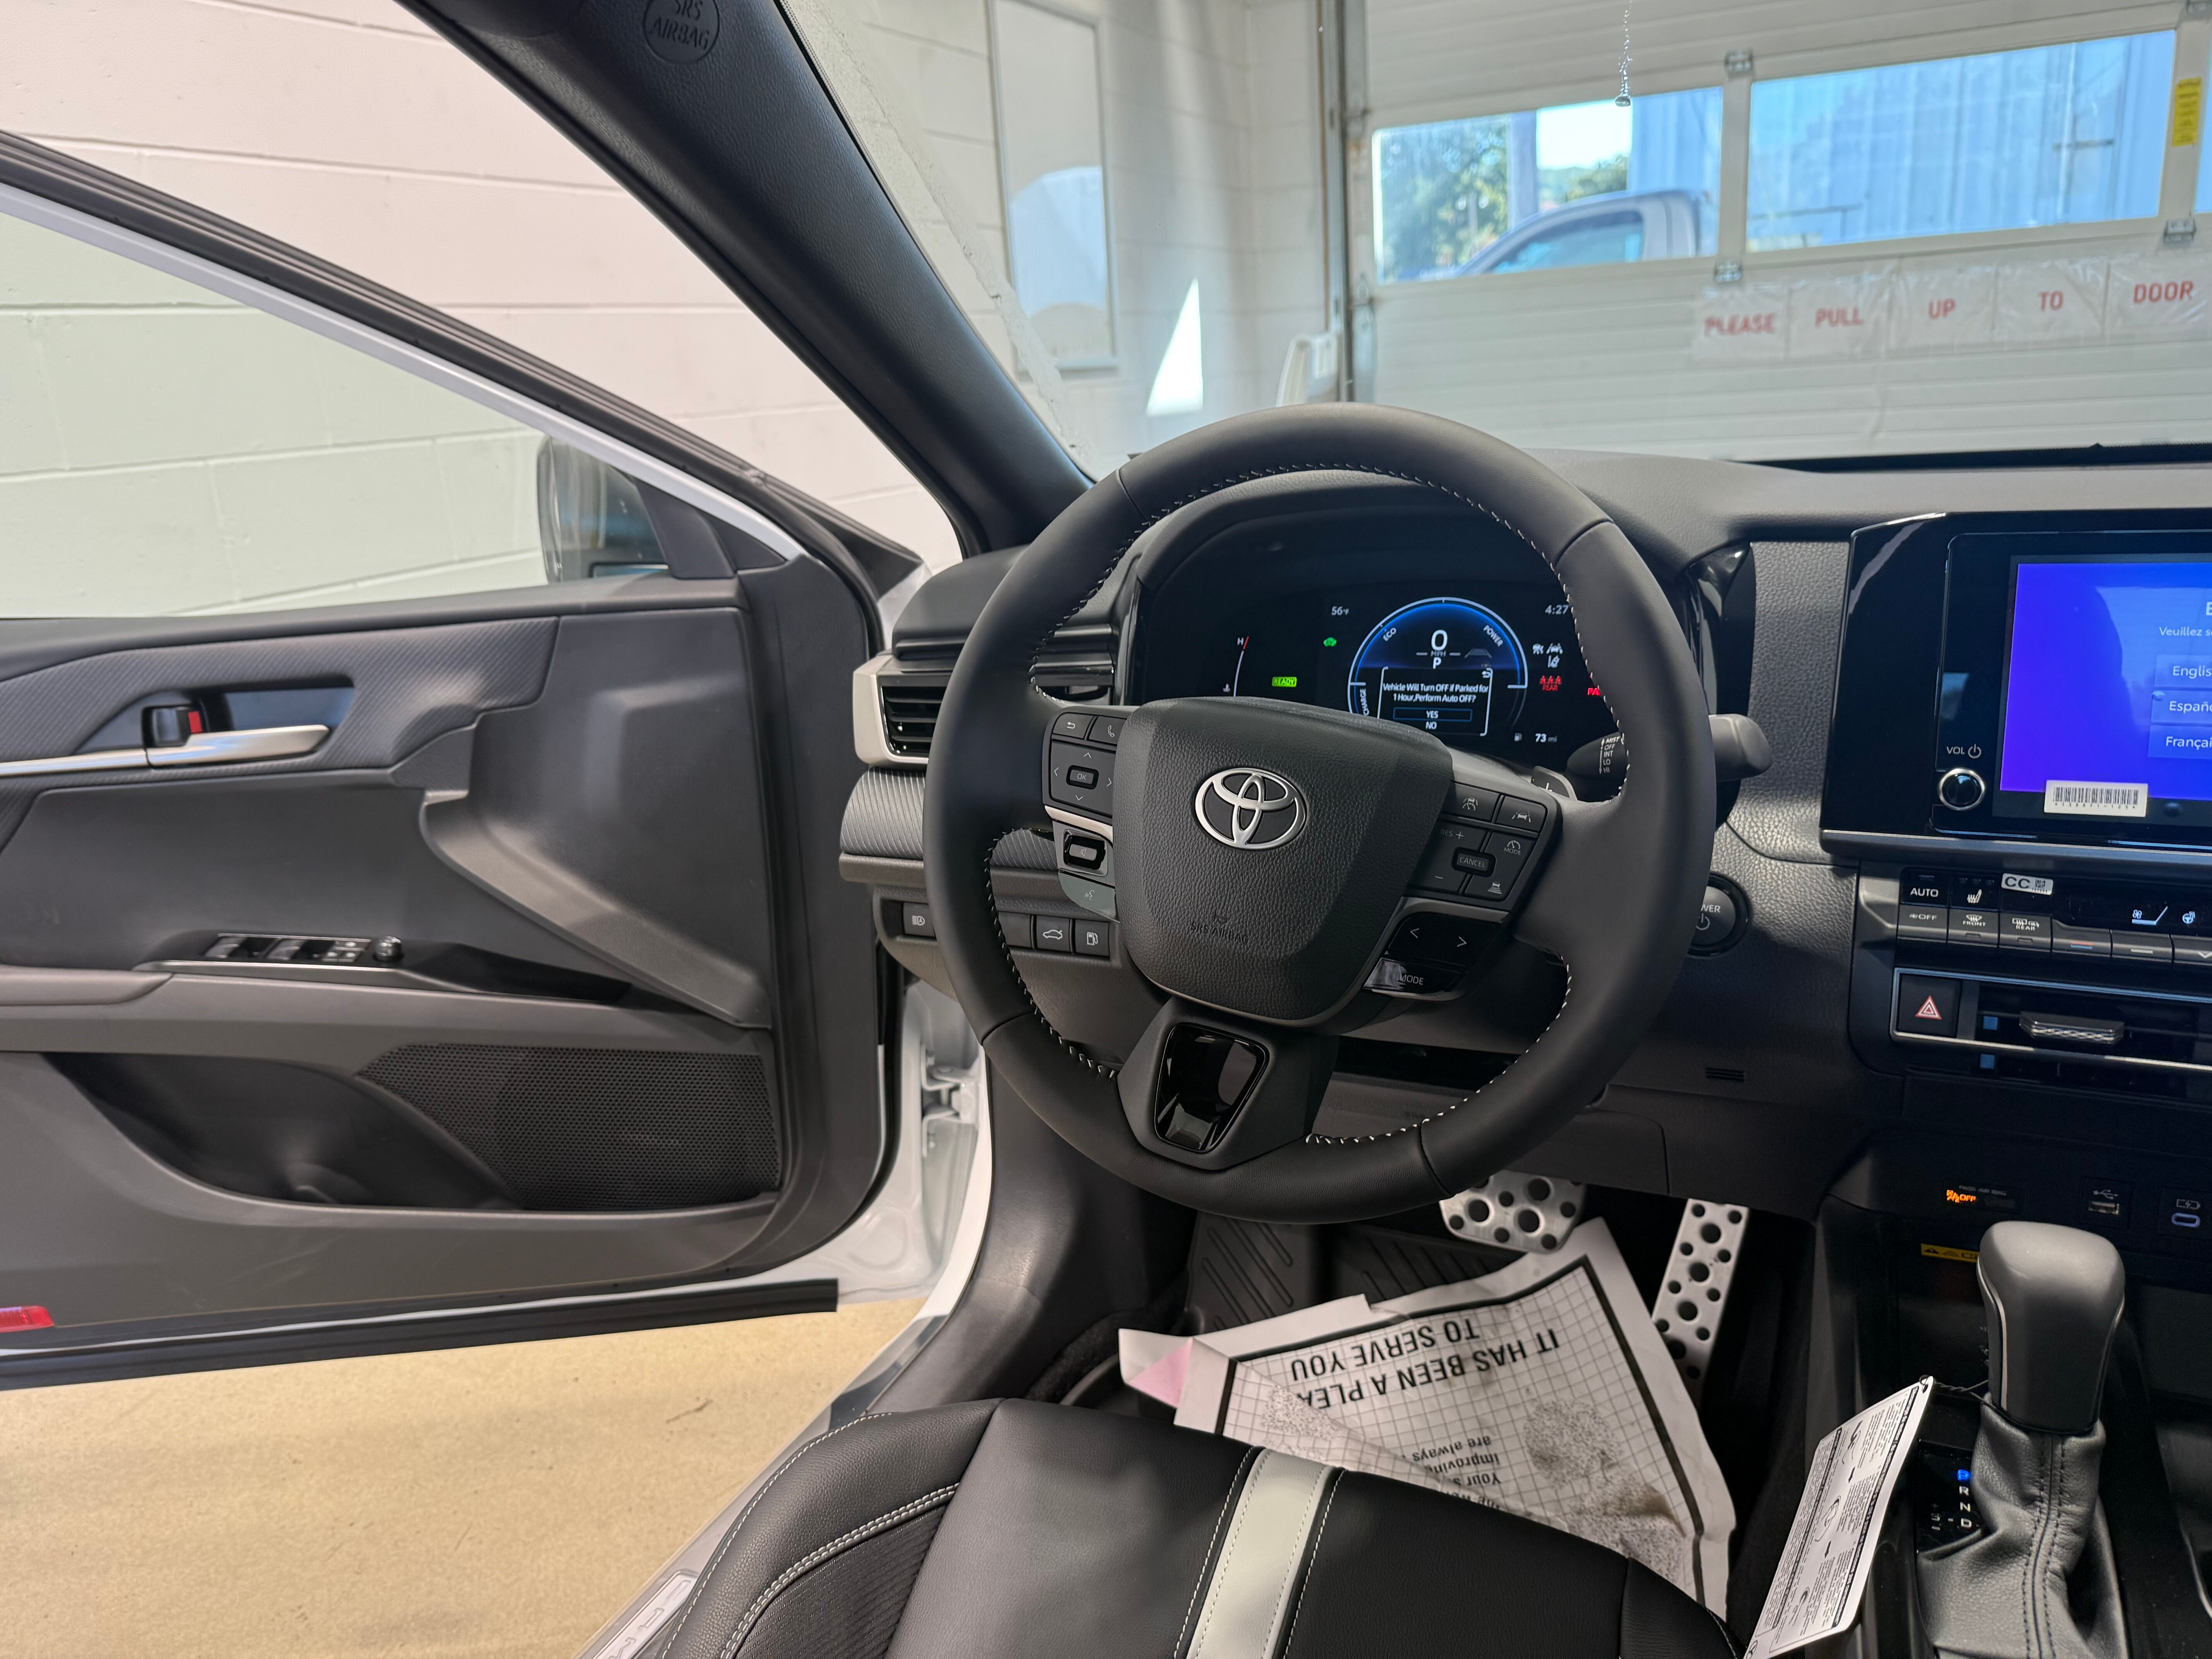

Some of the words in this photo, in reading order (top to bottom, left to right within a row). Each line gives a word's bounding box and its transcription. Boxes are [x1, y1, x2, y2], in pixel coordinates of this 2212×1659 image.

[649, 16, 709, 50] AIRBAG
[1705, 313, 1777, 335] PLEASE
[1814, 307, 1864, 328] PULL
[1928, 299, 1956, 319] UP
[2038, 290, 2063, 311] TO
[2133, 280, 2194, 304] DOOR
[1545, 605, 1569, 615] 4:27
[1382, 627, 1397, 642] ECO
[1483, 625, 1503, 647] POWER
[2159, 625, 2202, 636] Veuillez
[1433, 657, 1441, 669] P
[1383, 683, 1405, 691] Vehicle
[1406, 684, 1419, 692] Will
[1420, 684, 1435, 692] Turn
[1436, 684, 1449, 692] OFF
[1455, 684, 1478, 693] Parked
[1479, 685, 1489, 693] for
[1360, 688, 1370, 716] CHARGE
[1442, 694, 1458, 702] Auto
[1458, 695, 1476, 703] OFF?
[1426, 710, 1439, 719] YES
[1425, 721, 1437, 730] NO
[1535, 733, 1547, 743] 73
[1605, 736, 1621, 744] MIST
[1946, 746, 1965, 755] VOL
[1077, 773, 1087, 781] OK
[1440, 828, 1453, 837] RES
[1503, 847, 1522, 855] MODE
[1459, 856, 1486, 869] CANCEL
[2004, 876, 2030, 889] CC
[1910, 887, 1939, 898] AUTO
[1400, 973, 1424, 986] MODE
[1443, 1319, 1480, 1343] TO
[1351, 1325, 1436, 1367] SERVE
[1535, 1328, 1559, 1354] IT
[1472, 1339, 1528, 1372] HAS
[1291, 1351, 1346, 1381] YOU
[1397, 1355, 1465, 1390] BEEN
[1370, 1374, 1386, 1395] A
[1467, 1435, 1492, 1448] are
[1412, 1441, 1463, 1462] always
[1467, 1472, 1501, 1486] Your
[1958, 1469, 1970, 1481] P
[1959, 1486, 1970, 1496] R
[1960, 1501, 1971, 1512] N
[1961, 1518, 1972, 1528] D
